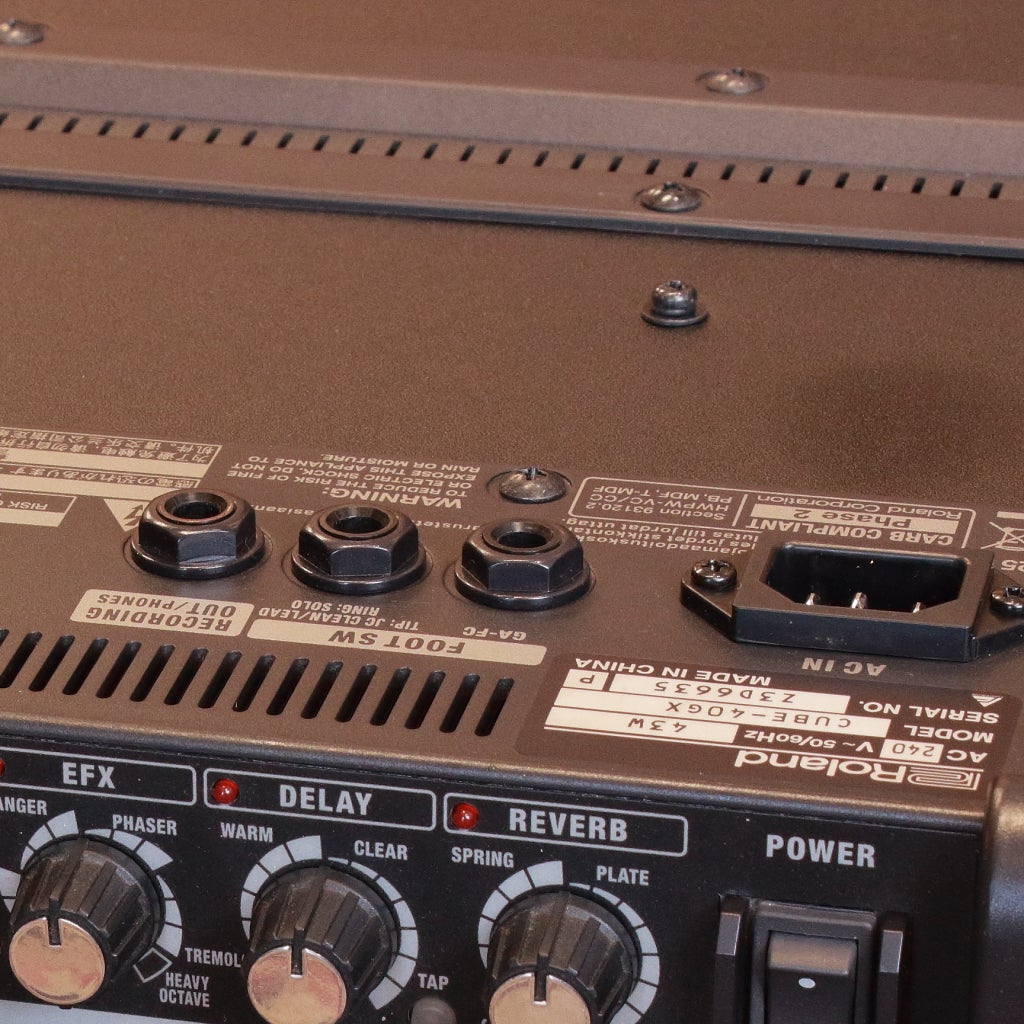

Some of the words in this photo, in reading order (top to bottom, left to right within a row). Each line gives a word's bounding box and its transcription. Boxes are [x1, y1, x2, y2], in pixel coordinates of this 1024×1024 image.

[231, 462, 266, 471] NOT
[248, 455, 269, 463] TO
[275, 458, 367, 471] APPLIANCE
[321, 453, 409, 467] MOISTURE.
[414, 461, 437, 469] OR
[227, 470, 264, 479] FIRE
[371, 466, 406, 475] THIS
[411, 469, 477, 481] EXPOSE
[442, 464, 481, 473] RAIN
[295, 476, 332, 485] RISK
[336, 480, 368, 488] THE
[364, 473, 444, 487] ELECTRIC
[448, 481, 472, 489] OR
[373, 483, 442, 495] REDUCE
[446, 489, 467, 497] TO
[592, 484, 651, 496] T-MDF
[8, 500, 48, 510] RISK
[323, 487, 462, 508] WARNING:
[590, 493, 730, 512] HWPW-VC/CC
[758, 494, 880, 513] Corporation
[586, 501, 654, 514] 93120.2
[660, 508, 726, 520] Section
[793, 509, 812, 519] 2
[888, 506, 962, 520] Roland
[562, 517, 616, 529] uttag.
[822, 511, 912, 528] Phase
[621, 523, 679, 535] jordat
[683, 529, 706, 537] till
[746, 518, 882, 540] COMPLIANT
[667, 534, 725, 546] jordet
[890, 530, 954, 546] CARB
[98, 594, 237, 618] OUT/PHONES
[291, 599, 333, 611] SOLO
[338, 604, 380, 615] RING:
[86, 607, 233, 632] RECORDING
[259, 606, 361, 625] CLEAN/LEAD
[364, 617, 385, 627] JC
[390, 619, 419, 630] TIP:
[328, 629, 378, 646] SW
[463, 626, 527, 641] GA-FC
[384, 635, 466, 654] FOOT
[576, 658, 655, 675] CHINA
[662, 666, 688, 678] IN
[801, 657, 837, 674] IN
[843, 660, 886, 676] AC
[580, 673, 595, 684] P
[695, 669, 771, 686] MADE
[654, 680, 795, 704] Z3D6635
[666, 701, 851, 729] CUBE-40GX
[860, 700, 901, 715] NO.
[909, 705, 998, 724] SERIAL
[628, 717, 687, 733] 43W
[744, 729, 837, 749] 50/60Hz
[904, 724, 994, 744] MODEL
[892, 742, 935, 757] 240
[947, 748, 988, 764] AC
[735, 749, 907, 783] Roland
[62, 762, 116, 789] EFX
[279, 784, 372, 816] DELAY
[112, 814, 177, 836] PHASER
[220, 822, 273, 842] WARM
[508, 808, 628, 842] REVERB
[354, 840, 408, 861] CLEAR
[451, 846, 514, 868] SPRING
[766, 834, 876, 868] POWER
[596, 865, 650, 886] PLATE
[184, 947, 244, 968] TREMOL
[165, 972, 209, 990] HEAVY
[418, 973, 449, 990] TAP
[159, 989, 210, 1008] OCTAVE
